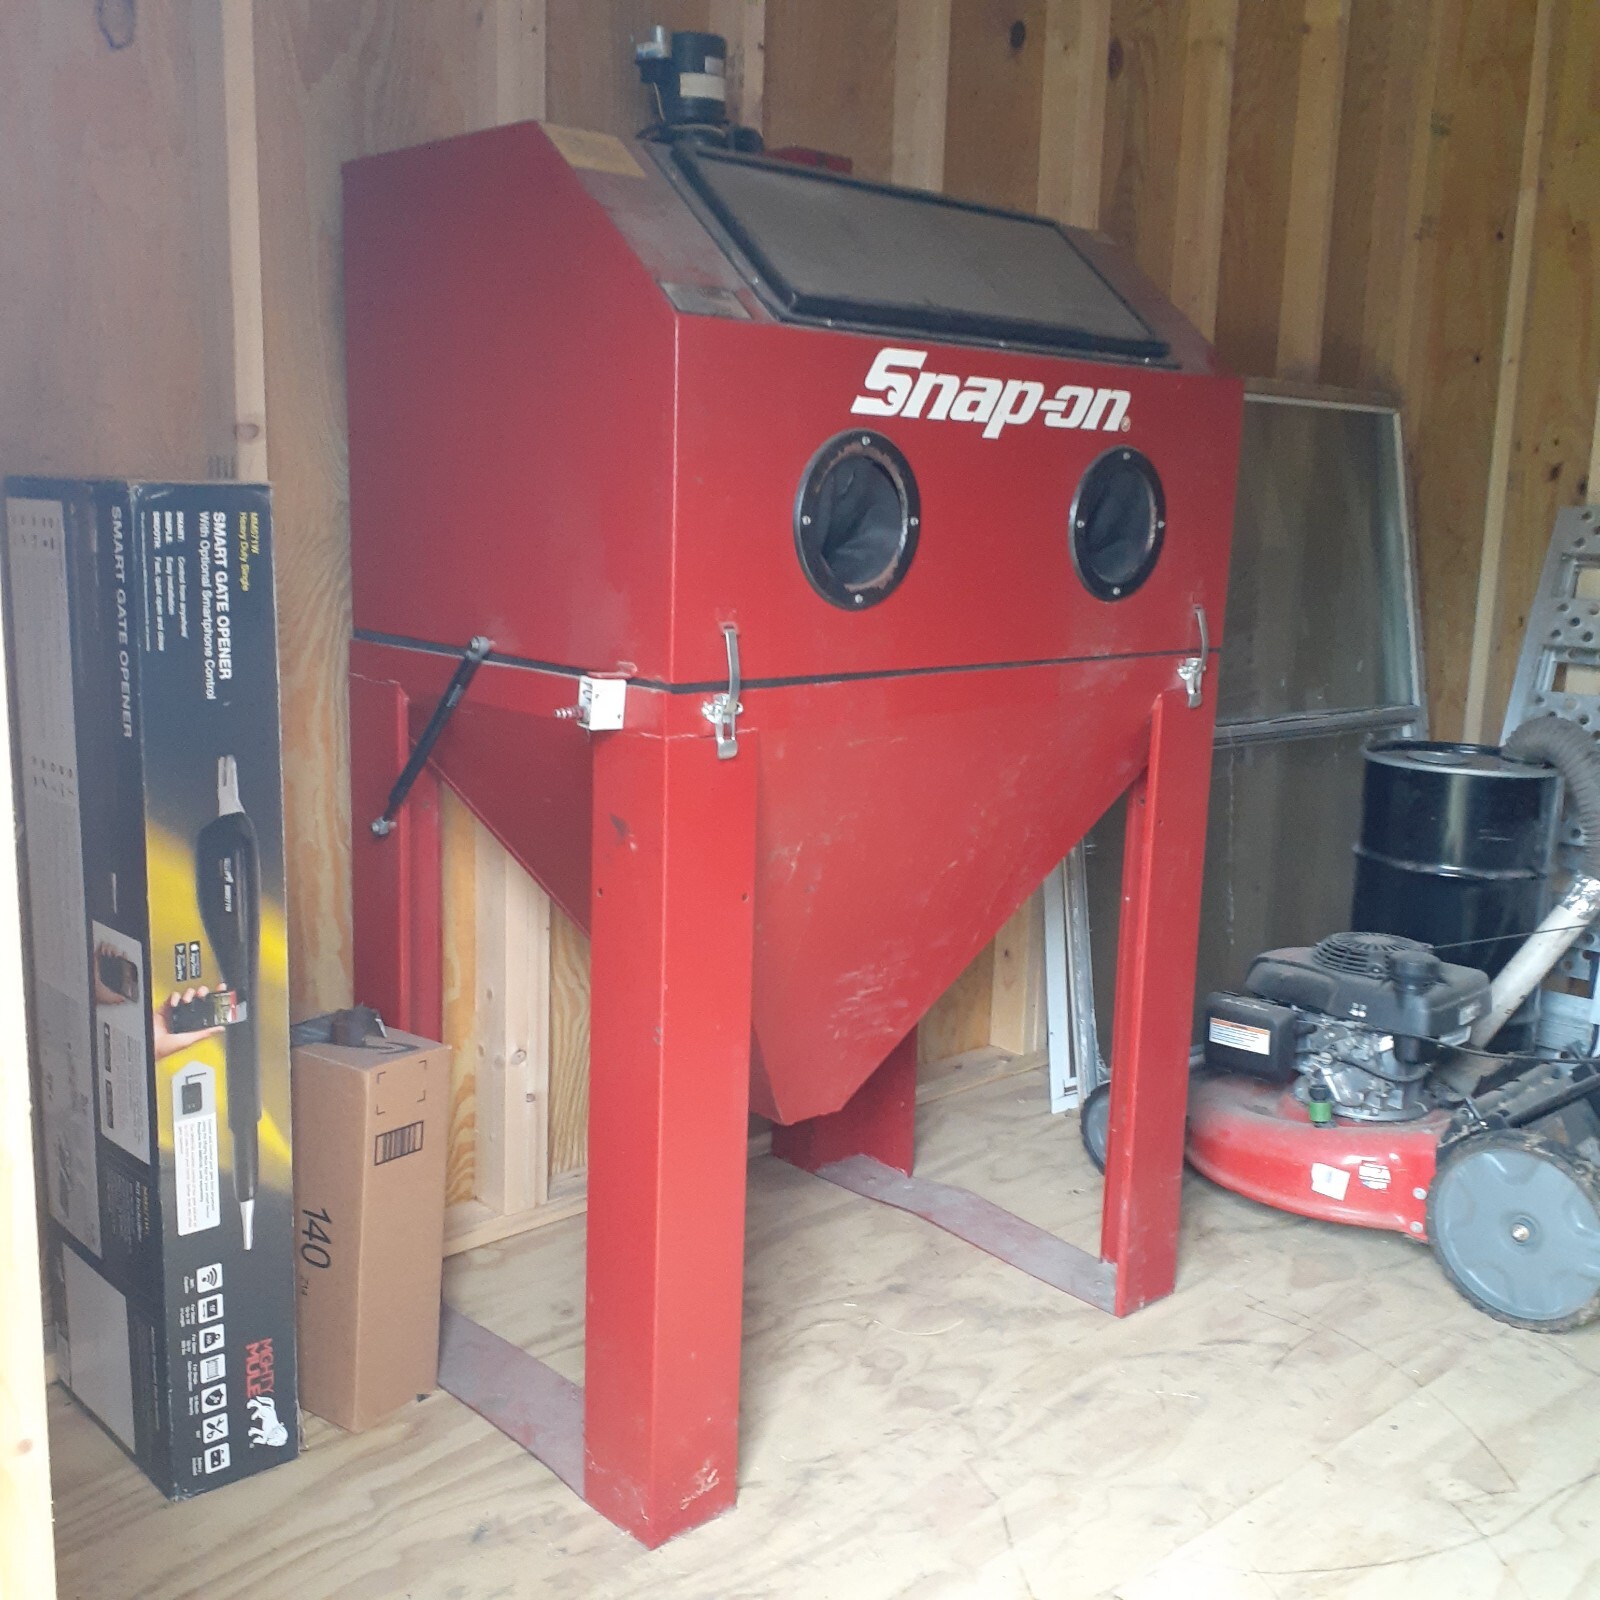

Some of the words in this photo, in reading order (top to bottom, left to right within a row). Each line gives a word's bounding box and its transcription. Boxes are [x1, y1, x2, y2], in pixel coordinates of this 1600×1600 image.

[850, 347, 1131, 440] Snap-on
[111, 505, 125, 583] SMART
[199, 512, 210, 537] With
[212, 512, 227, 568] SMART
[238, 512, 248, 540] Heavy
[239, 541, 249, 563] Duty
[198, 540, 212, 587] Optional
[215, 571, 230, 612] GATE
[115, 588, 128, 645] GATE
[201, 590, 214, 657] Smartphone
[216, 616, 232, 680] OPENER
[119, 650, 132, 738] OPENER
[204, 660, 216, 700] Control
[301, 1208, 332, 1269] 140
[245, 1342, 261, 1398] MULE
[260, 1338, 275, 1393] MIGHTY
